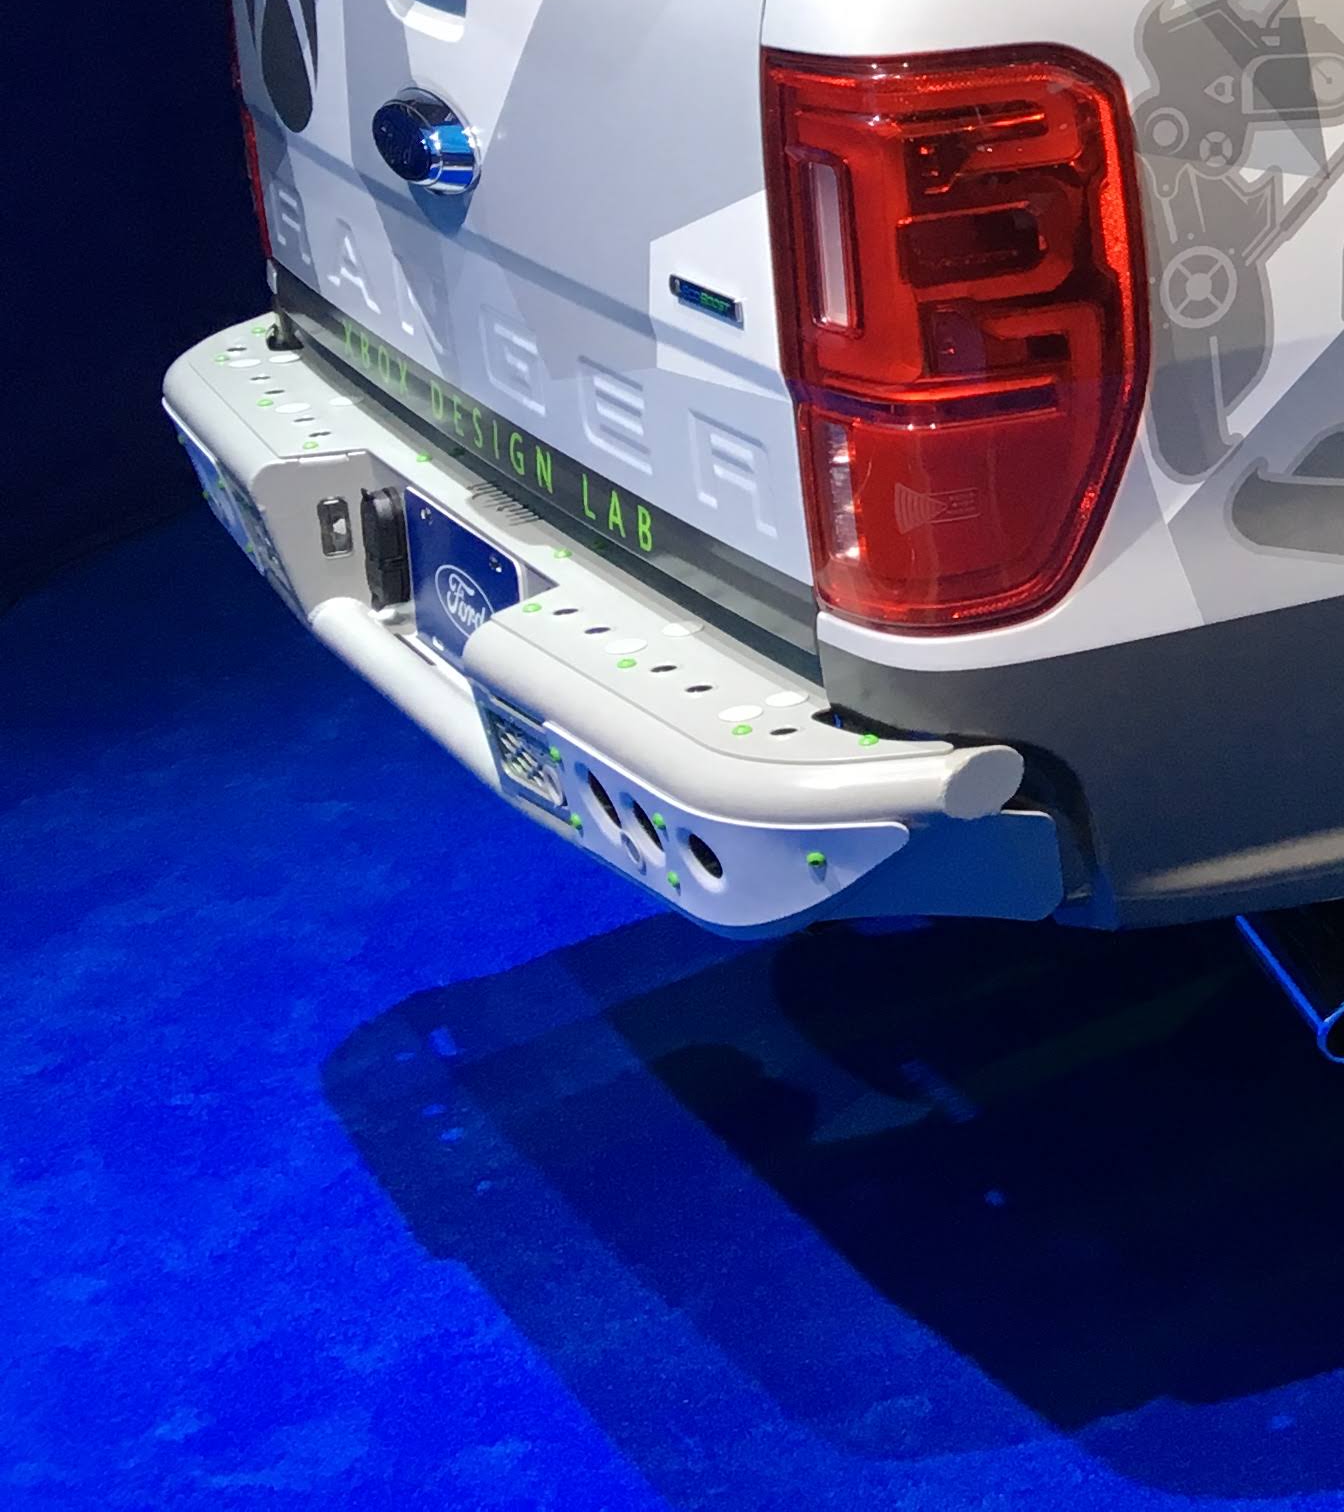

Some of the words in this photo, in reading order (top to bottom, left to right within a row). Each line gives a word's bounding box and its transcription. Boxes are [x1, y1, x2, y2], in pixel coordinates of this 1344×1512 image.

[267, 182, 780, 539] RANGER
[342, 317, 410, 393] XBOX
[429, 379, 554, 495] DESIGN
[582, 473, 654, 553] LAB
[447, 573, 486, 629] Ford
